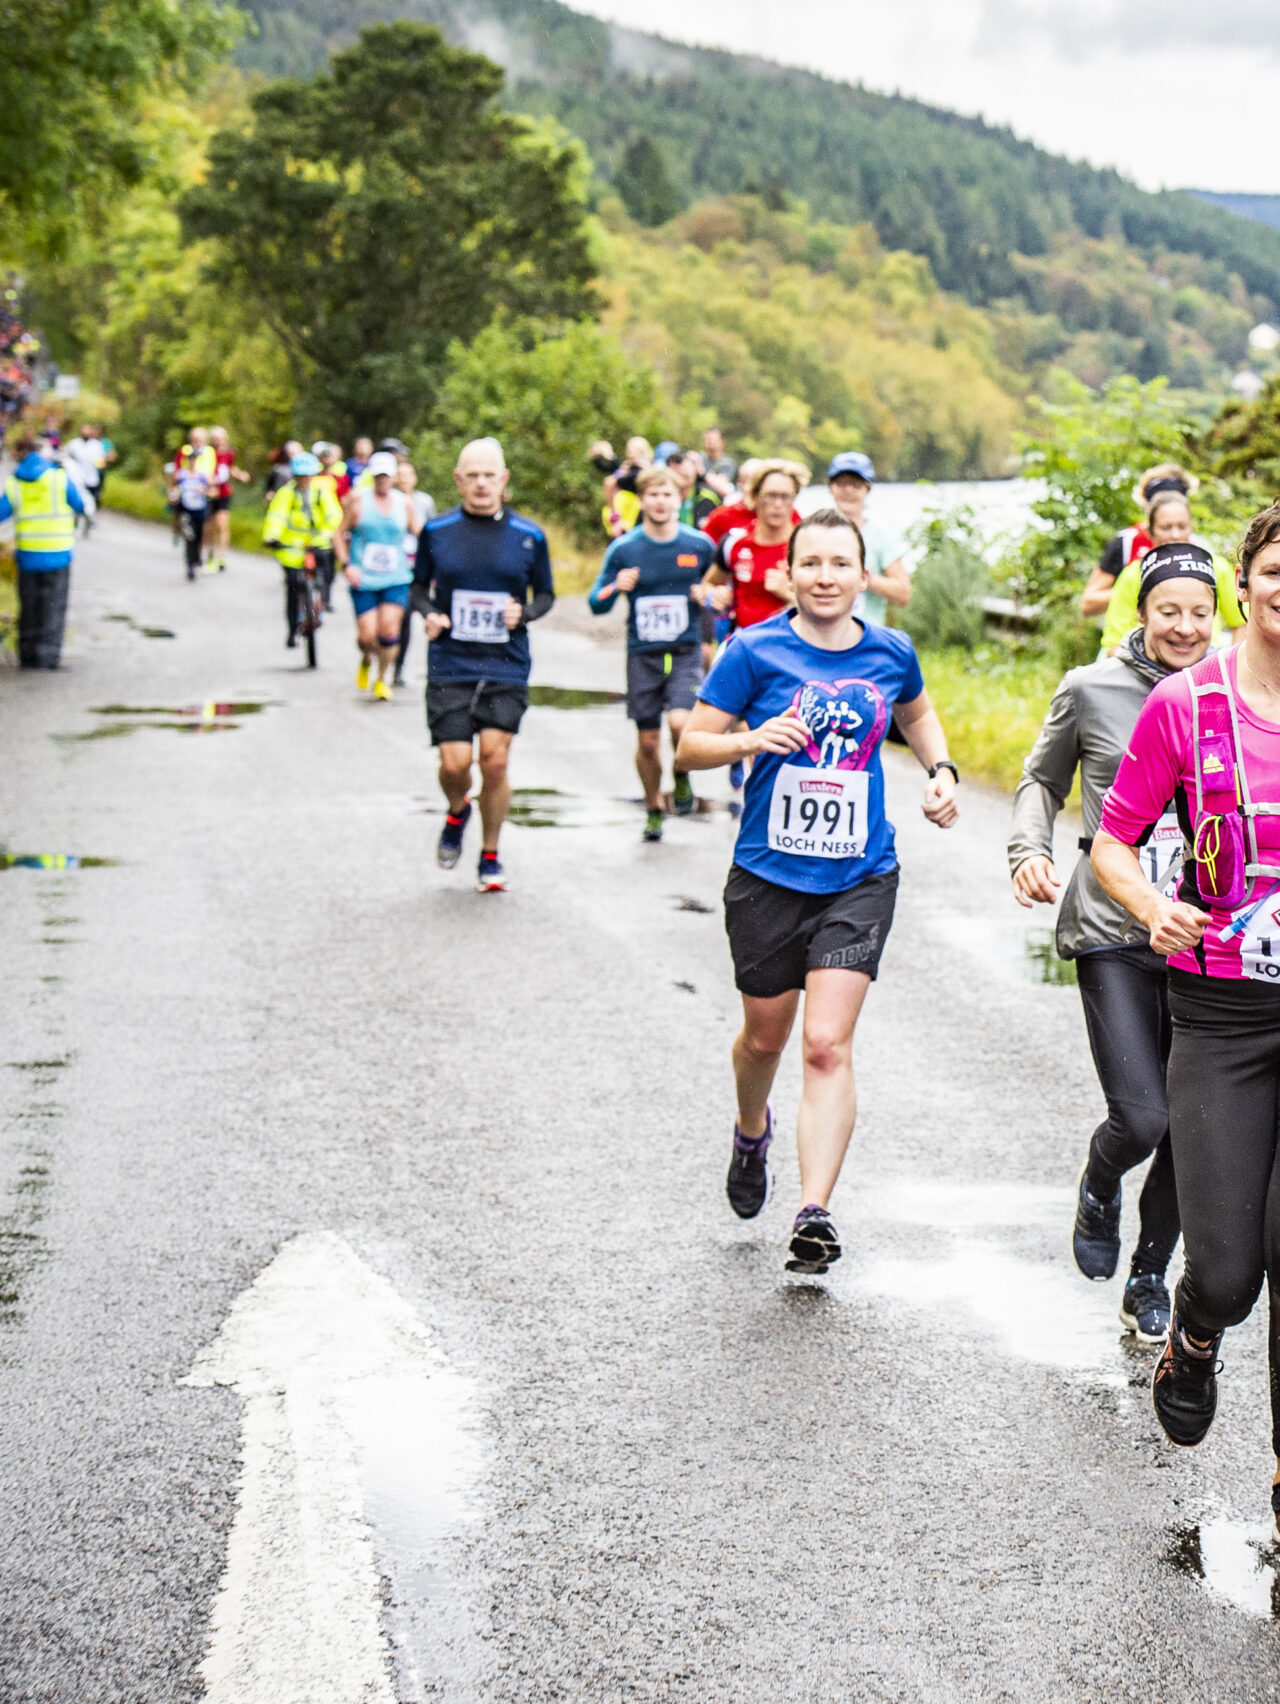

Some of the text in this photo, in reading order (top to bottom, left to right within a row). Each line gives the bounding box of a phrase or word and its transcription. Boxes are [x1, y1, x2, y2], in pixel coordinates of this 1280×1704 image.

[782, 795, 855, 836] 1991
[775, 834, 858, 854] LOCH NESS
